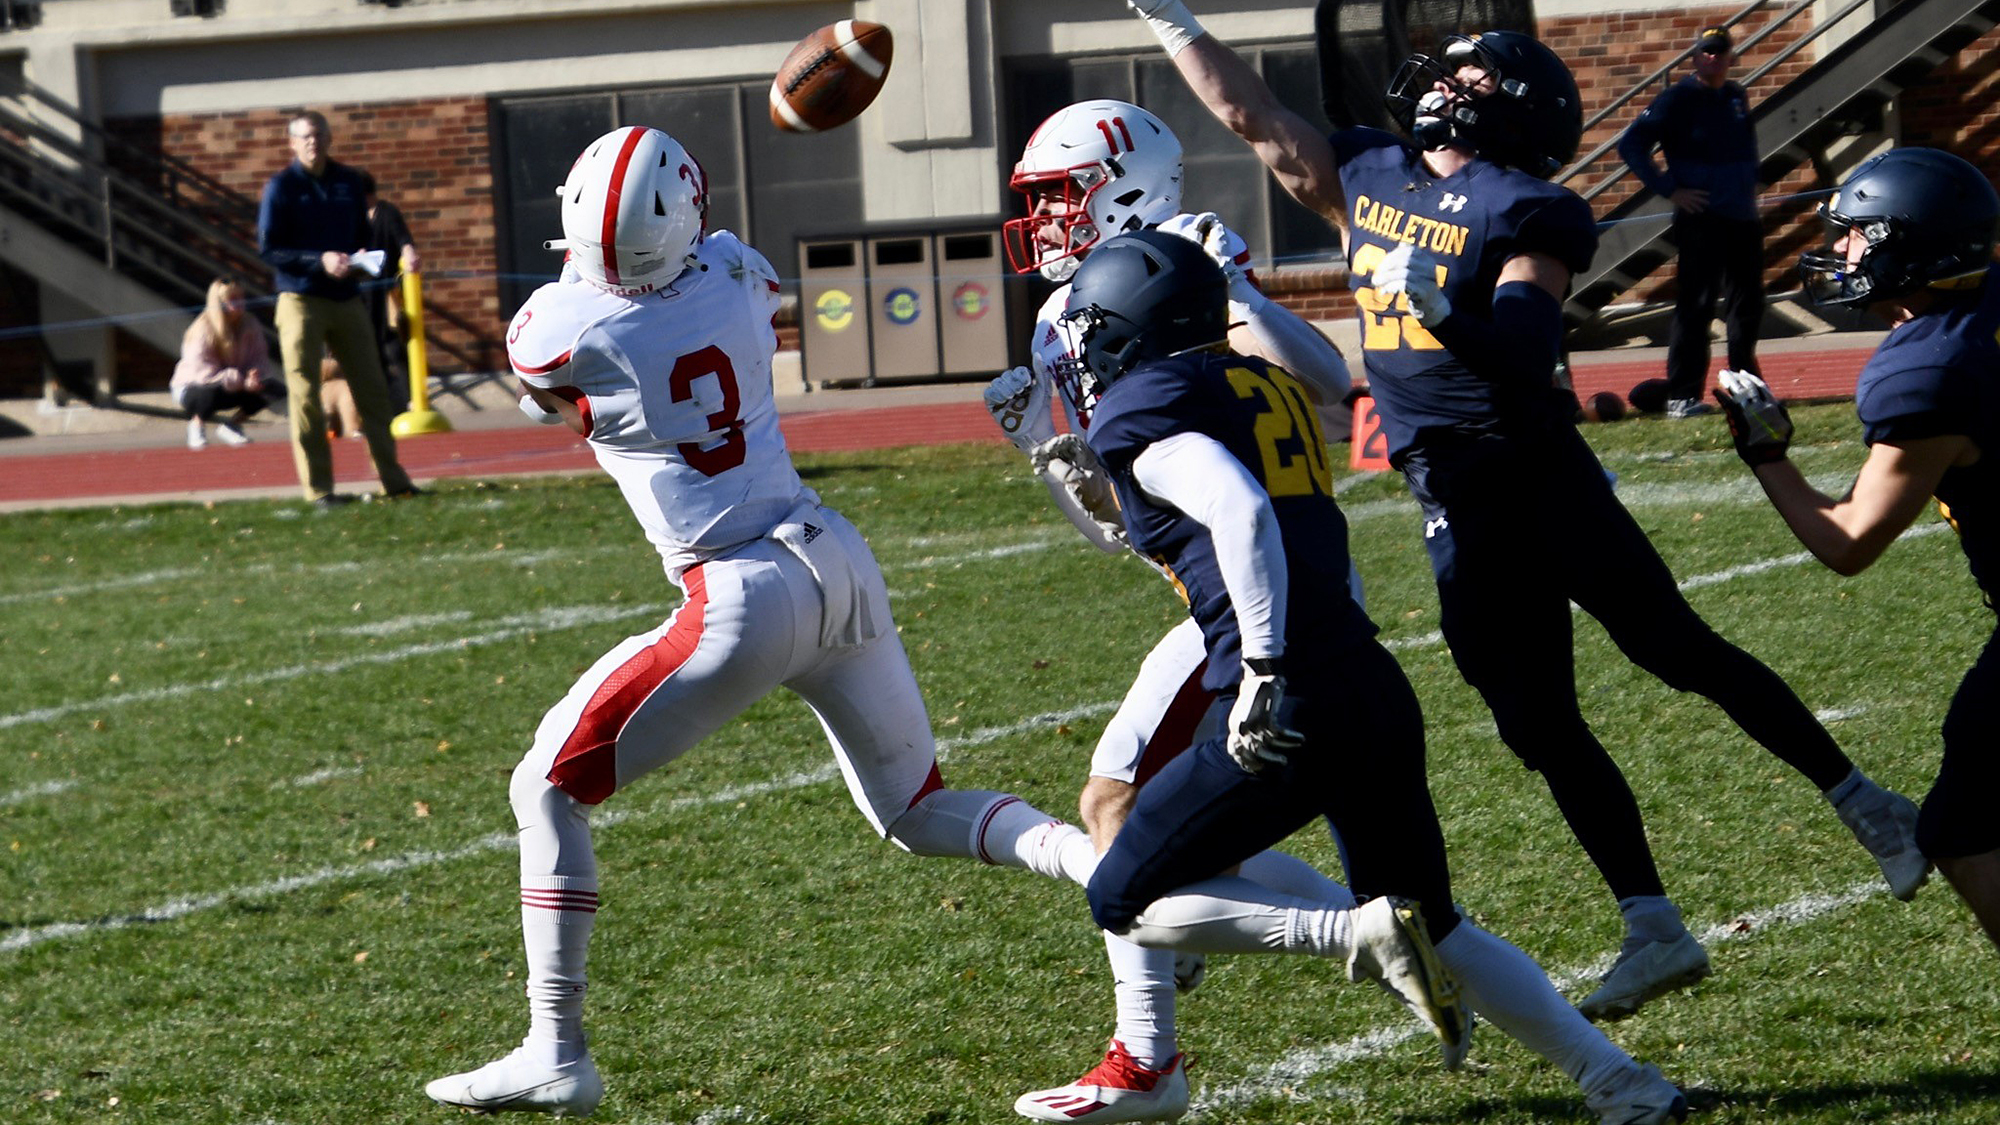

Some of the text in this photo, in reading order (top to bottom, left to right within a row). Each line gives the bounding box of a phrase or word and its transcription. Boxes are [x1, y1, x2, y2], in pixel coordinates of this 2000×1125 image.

[1096, 116, 1135, 155] 11
[679, 163, 702, 206] 3
[1354, 194, 1469, 256] CARLETON
[509, 310, 532, 344] 3
[669, 344, 746, 477] 3
[1225, 367, 1333, 497] 20
[1362, 404, 1384, 458] 2
